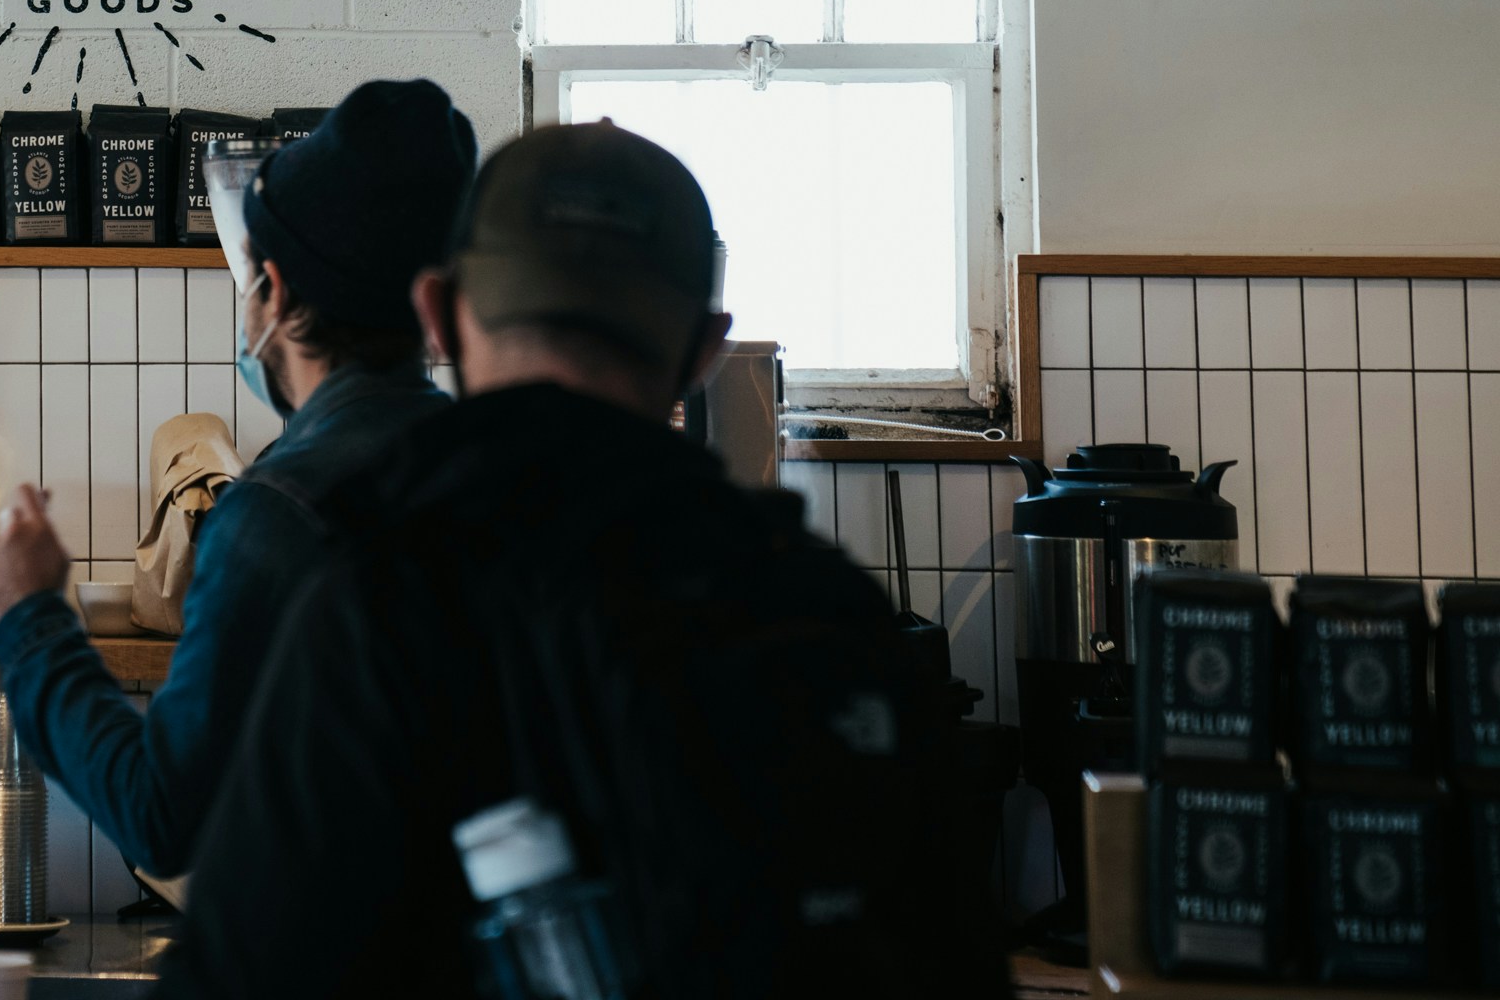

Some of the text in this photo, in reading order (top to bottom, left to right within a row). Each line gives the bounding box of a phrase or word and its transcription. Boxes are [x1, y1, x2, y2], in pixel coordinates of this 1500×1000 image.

[12, 135, 65, 147] CHROME
[191, 131, 244, 142] CHROME
[102, 139, 155, 150] CHROME
[189, 195, 211, 206] YEL
[15, 200, 66, 213] YELLOW
[103, 205, 155, 217] YELLOW
